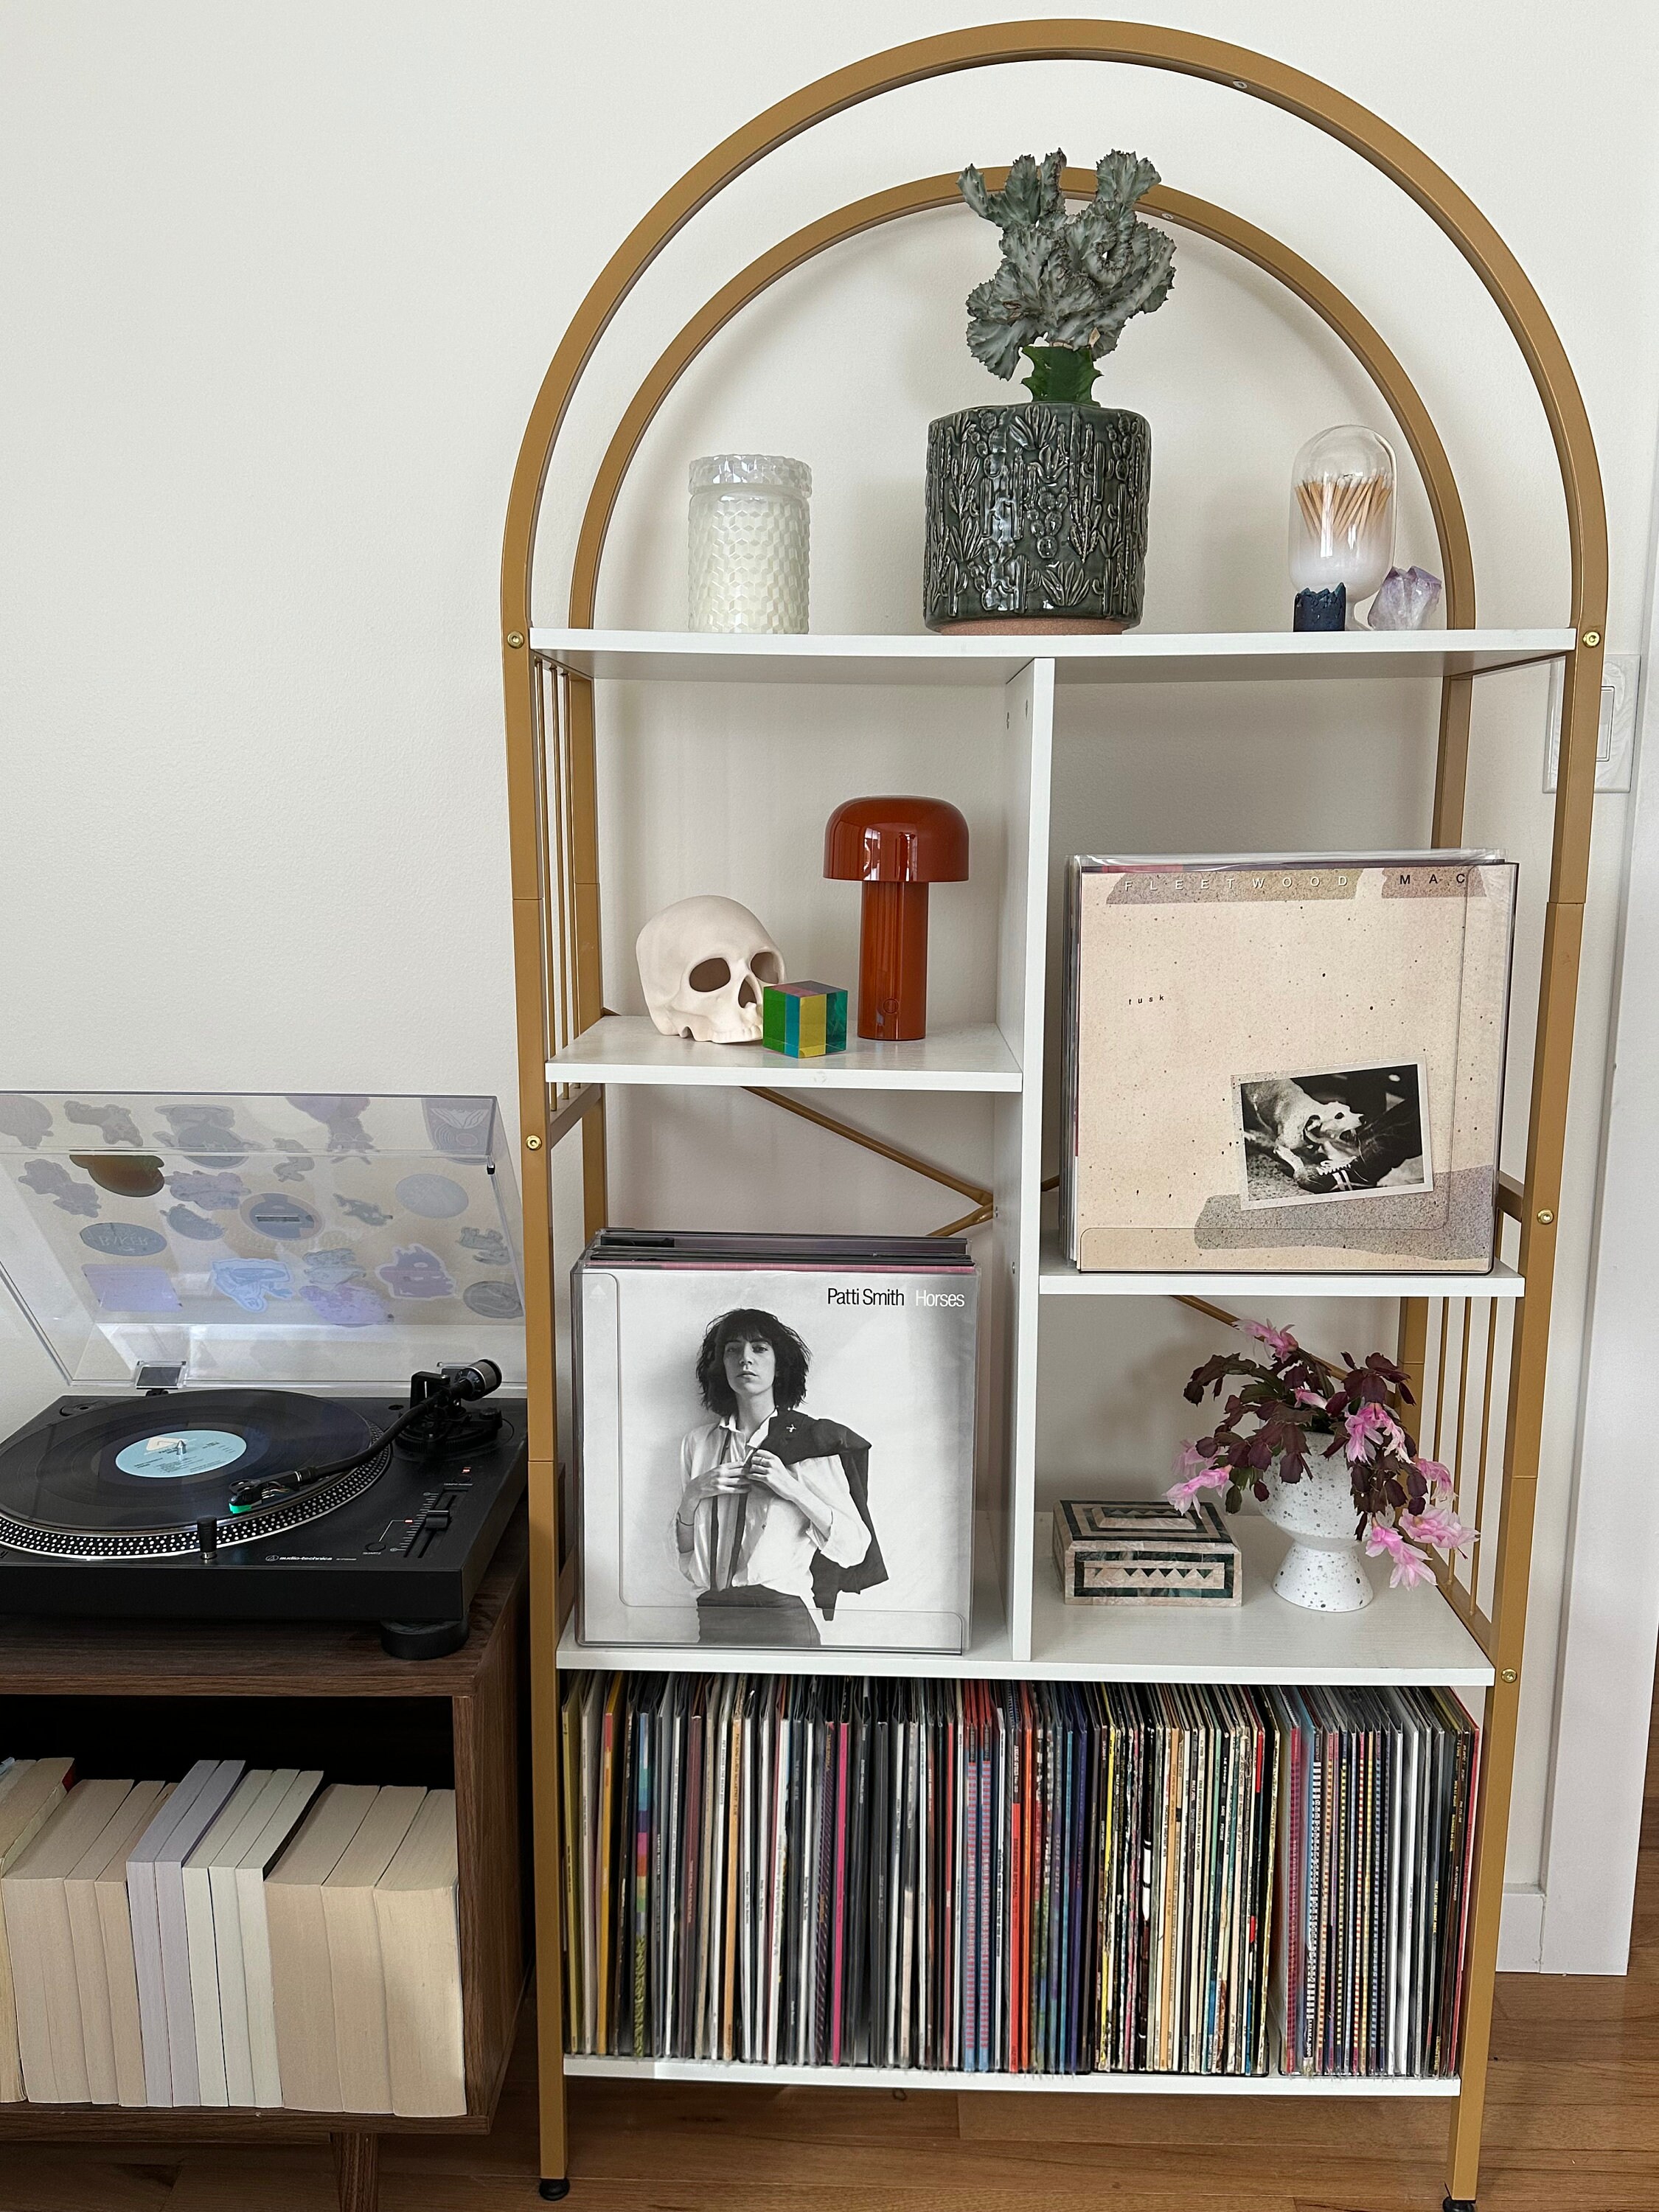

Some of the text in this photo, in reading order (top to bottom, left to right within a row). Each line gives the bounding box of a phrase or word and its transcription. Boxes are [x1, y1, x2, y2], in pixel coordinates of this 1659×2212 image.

[1124, 872, 1467, 892] FLEETWOOD MAC
[1129, 994, 1164, 1005] tusk
[827, 1287, 965, 1307] Patti Smith Horses
